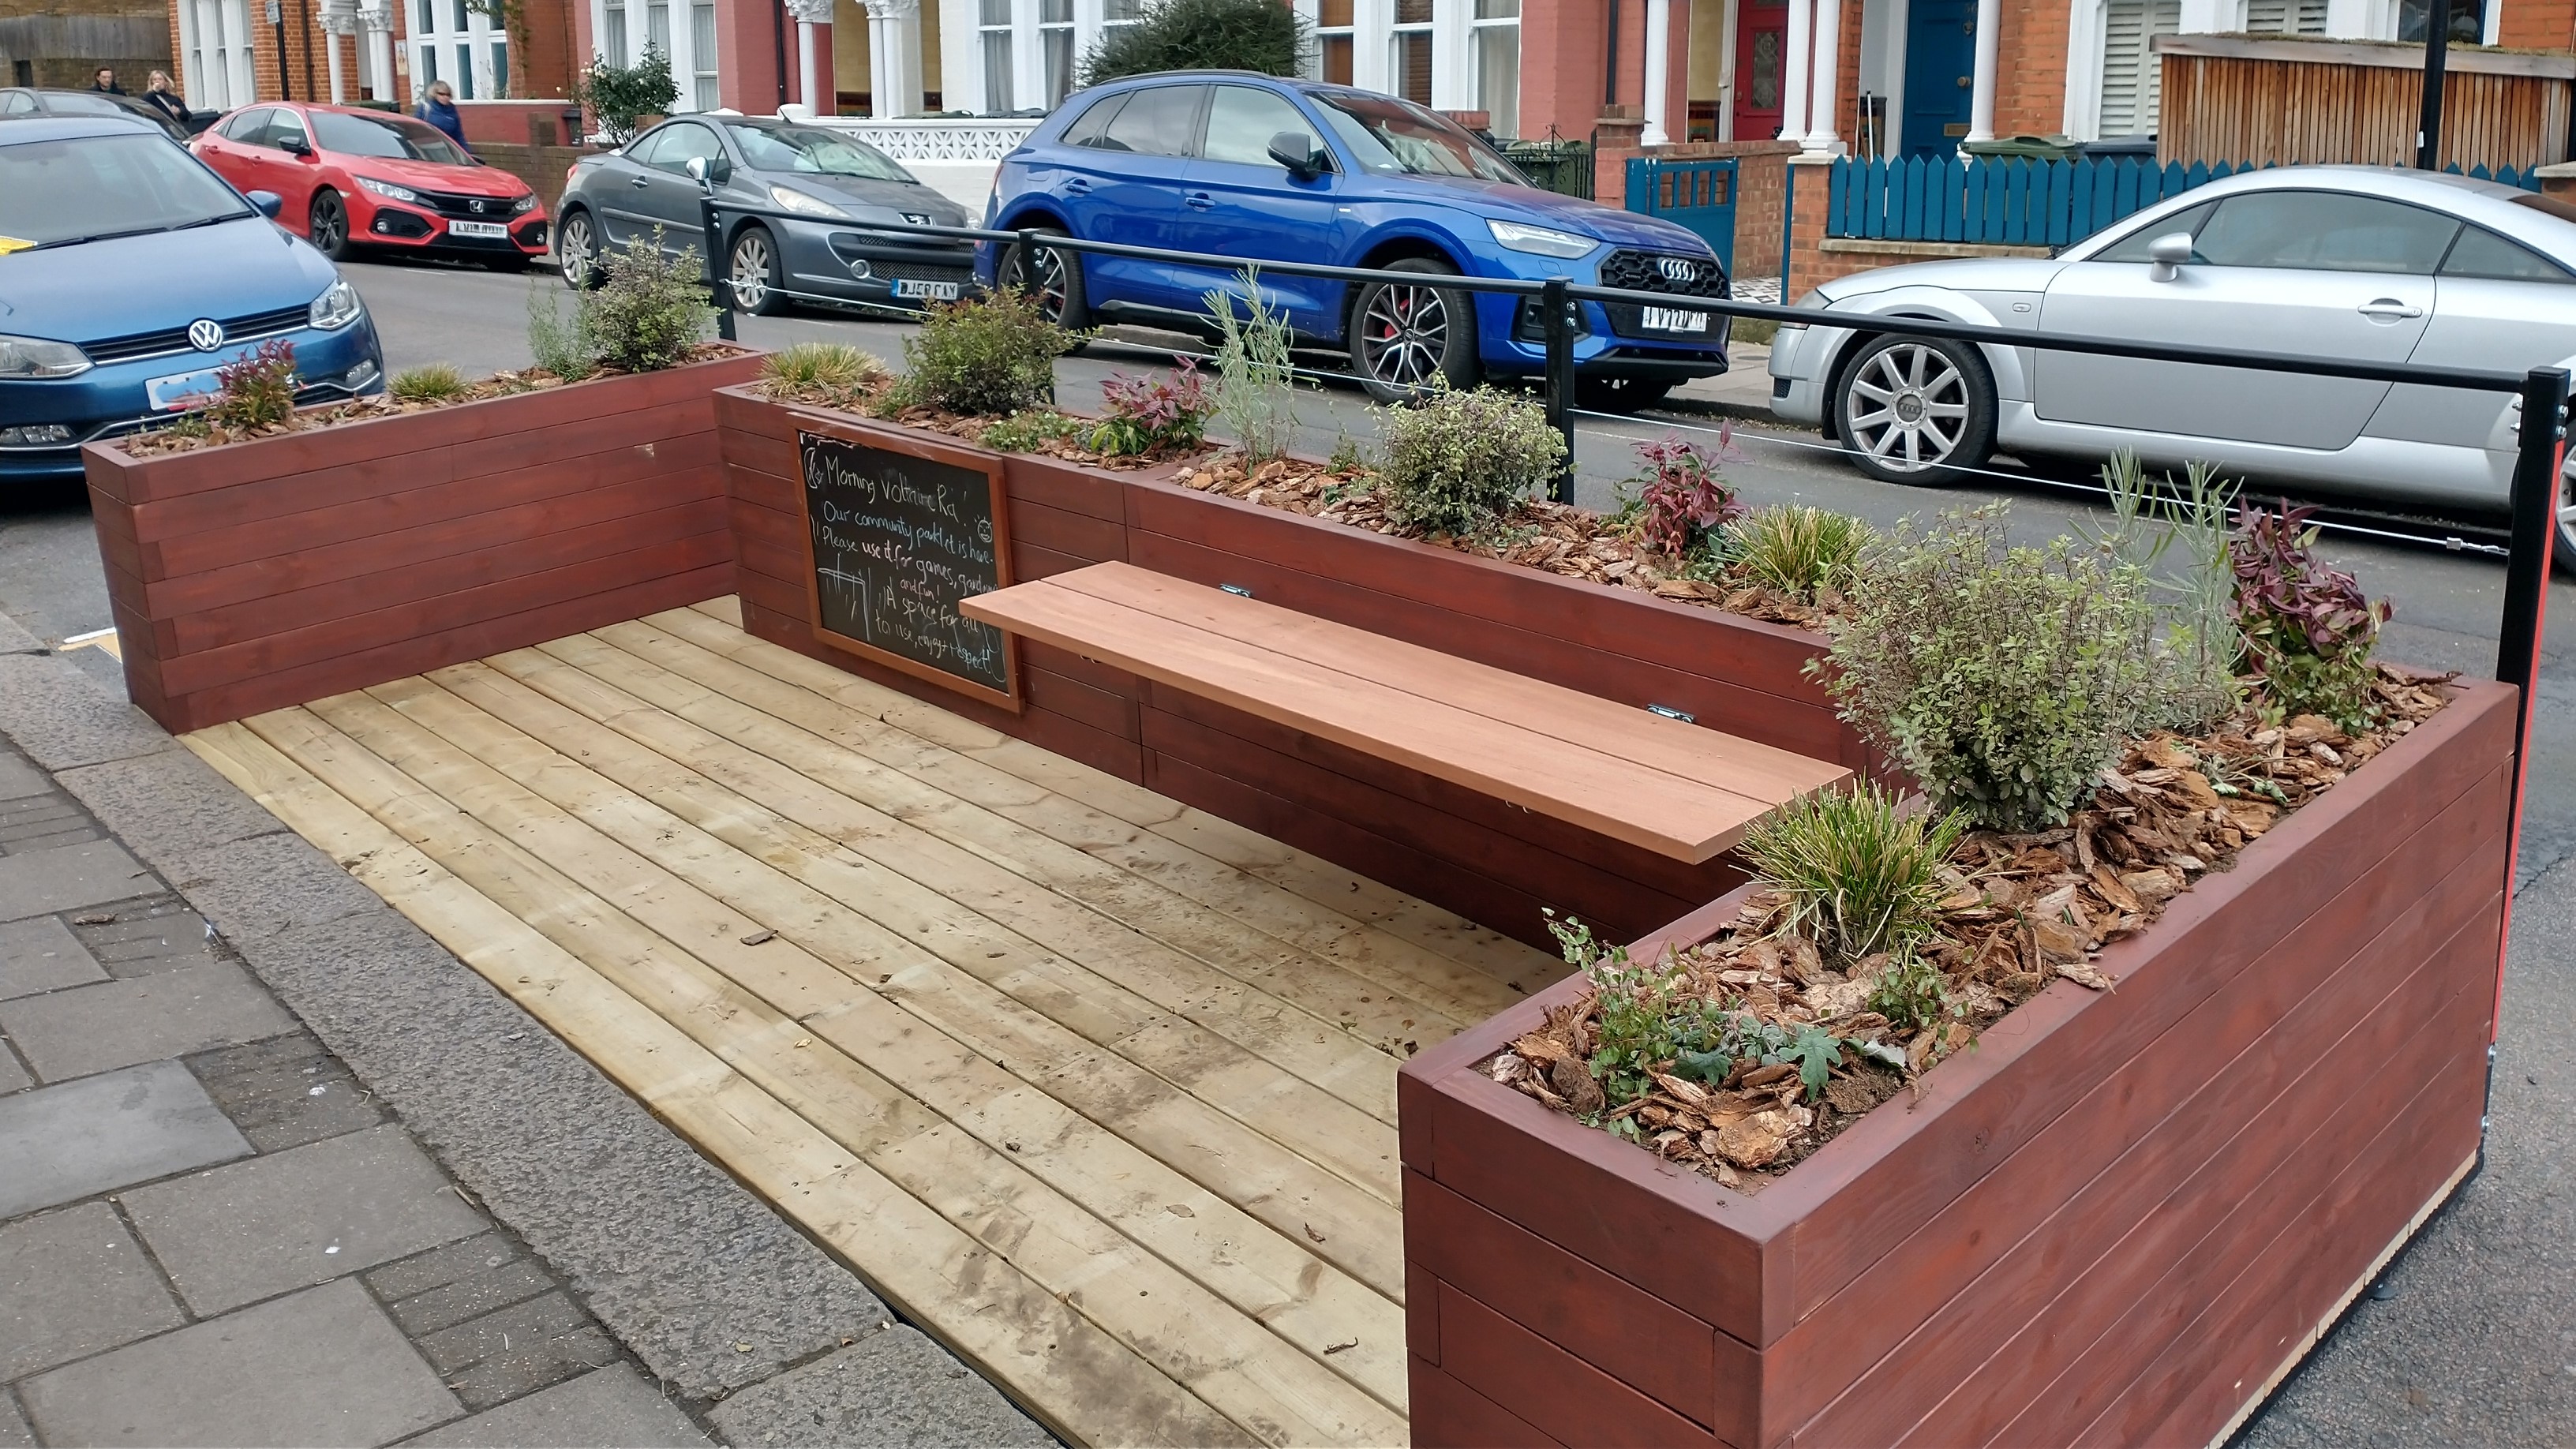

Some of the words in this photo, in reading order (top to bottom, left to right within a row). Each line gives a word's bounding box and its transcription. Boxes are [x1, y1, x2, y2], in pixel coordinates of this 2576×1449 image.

[825, 455, 875, 504] Morning
[823, 500, 850, 521] Our
[822, 526, 859, 552] Please
[862, 541, 881, 559] use
[884, 539, 893, 563] it
[893, 545, 912, 570] for
[875, 608, 890, 635] to
[886, 585, 897, 609] A
[940, 604, 958, 628] for
